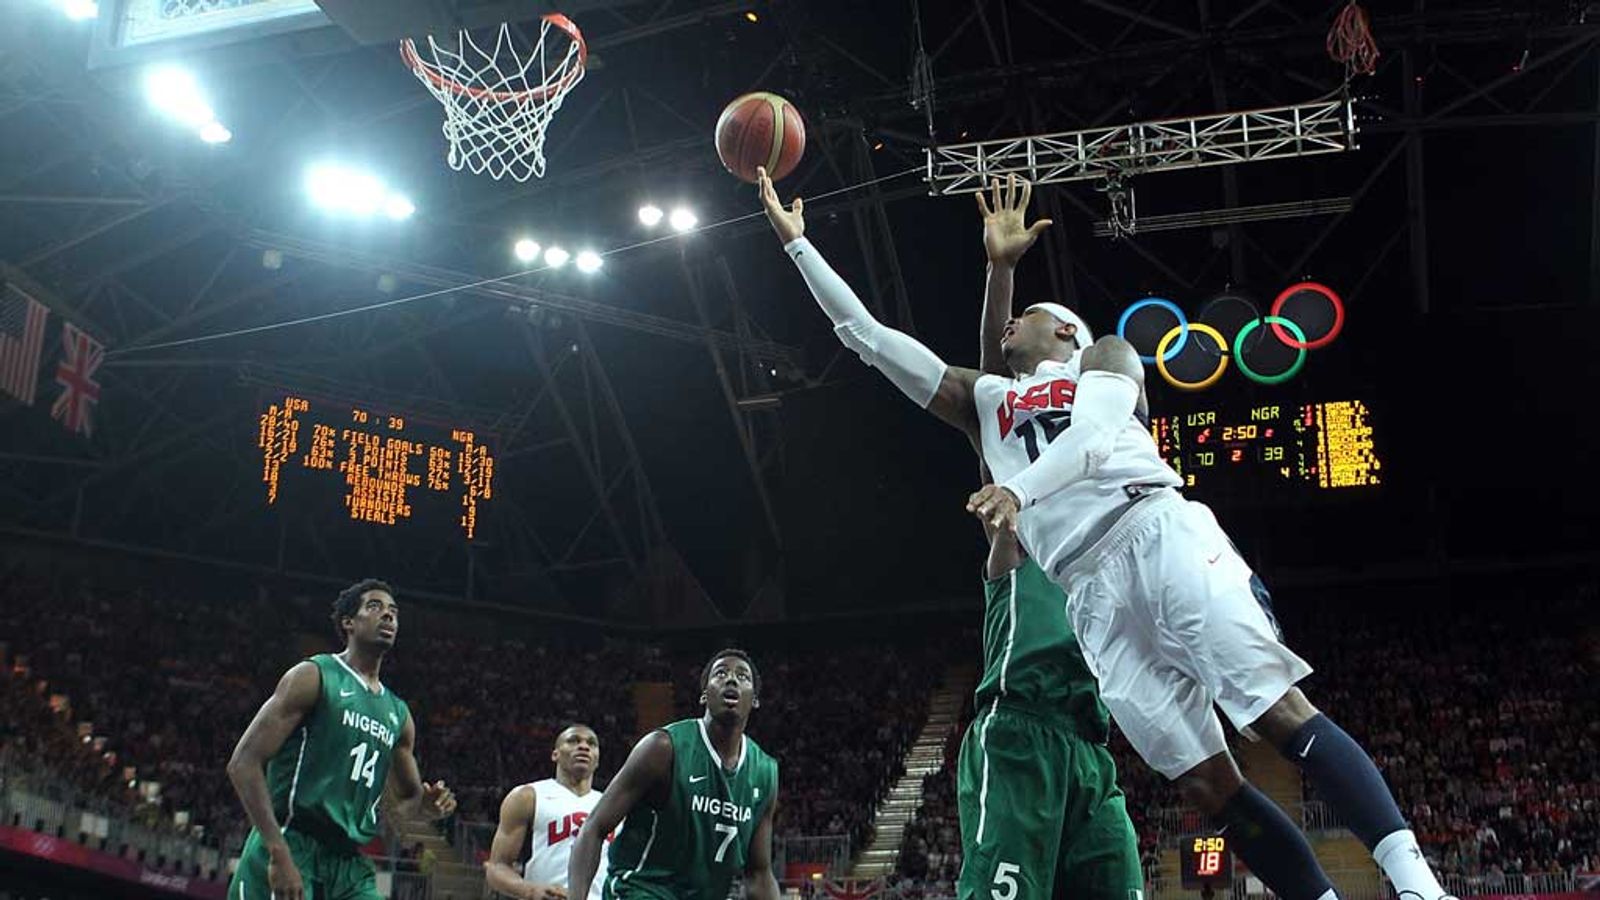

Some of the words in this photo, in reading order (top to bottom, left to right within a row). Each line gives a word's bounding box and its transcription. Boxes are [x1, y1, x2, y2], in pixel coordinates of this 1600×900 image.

[284, 396, 309, 412] USA
[352, 409, 368, 423] 70
[388, 416, 404, 430] 39
[452, 429, 474, 443] NGR
[997, 379, 1077, 440] USA
[1187, 411, 1216, 427] USA
[1251, 405, 1280, 421] NGR
[313, 423, 336, 438] 70%
[342, 429, 380, 448] FIELD
[386, 437, 424, 455] GOALS
[1222, 425, 1258, 441] 2:50
[349, 441, 358, 454] 2
[363, 443, 408, 464] POINTS
[1195, 452, 1215, 466] 70
[1231, 449, 1242, 462] 2
[1264, 446, 1284, 461] 39
[303, 454, 333, 470] 100%
[339, 461, 370, 478] FREE
[377, 467, 421, 487] THROWS
[362, 454, 408, 474] POINTS
[427, 466, 450, 481] 27%
[346, 473, 406, 495] REBOUNDS
[352, 484, 405, 506] ASSISTS
[345, 494, 411, 517] TURNOVERS
[350, 505, 396, 525] STEALS
[342, 708, 395, 751] NIGERIA
[350, 742, 380, 789] 14
[691, 794, 752, 822] NIGERIA
[547, 811, 614, 847] US
[714, 823, 739, 863] 7
[1193, 837, 1225, 853] 2:50
[1200, 852, 1220, 871] 18
[990, 861, 1021, 900] 5
